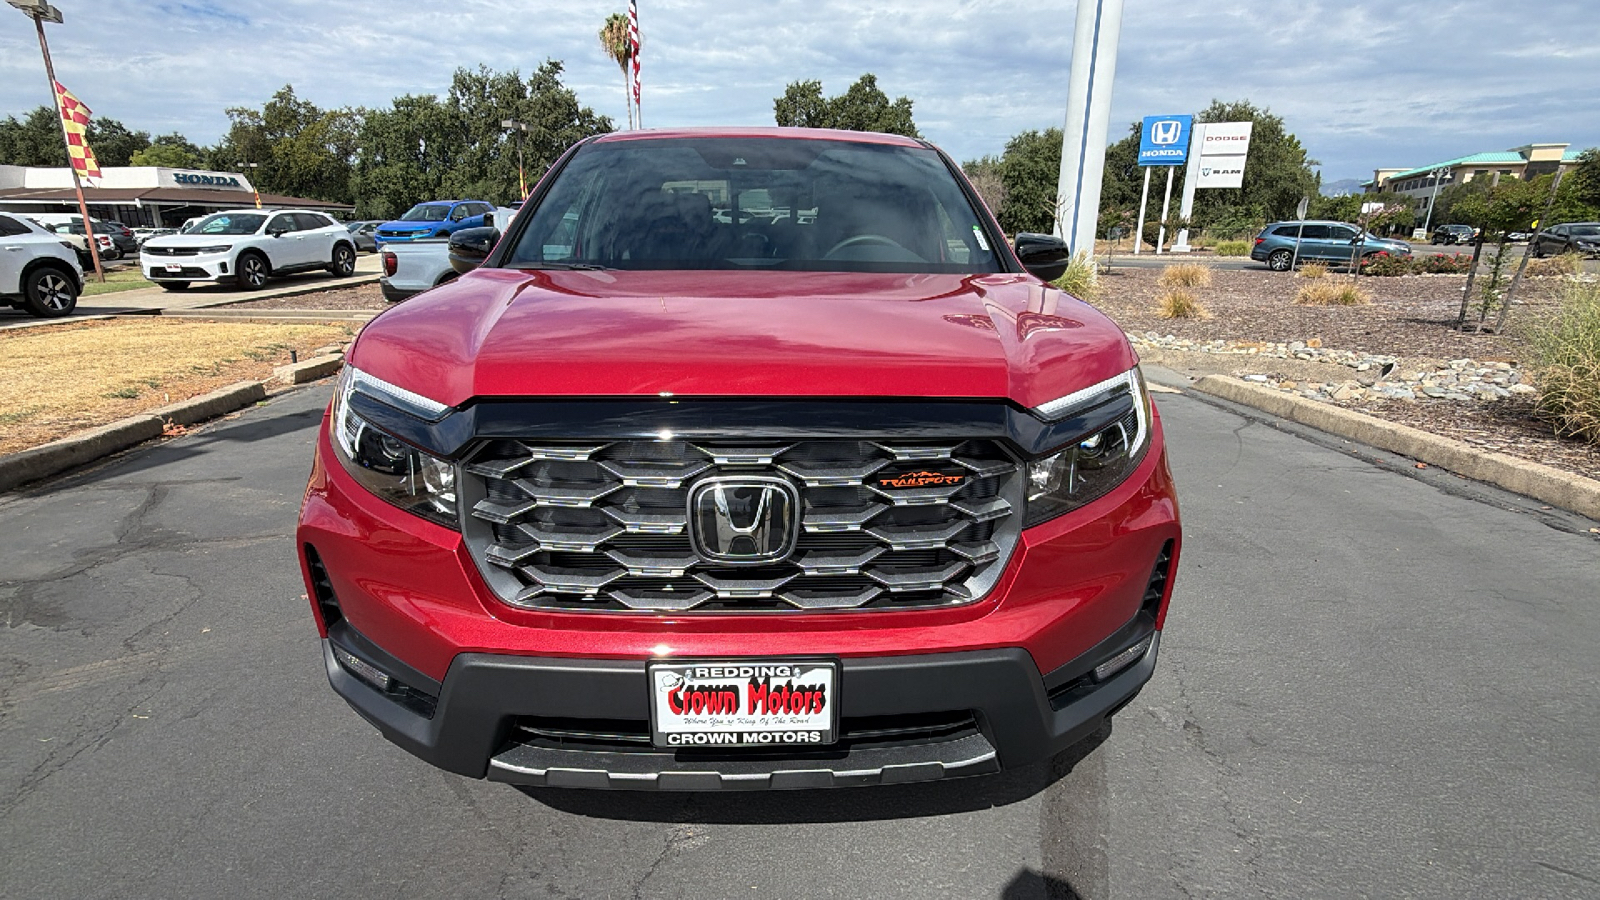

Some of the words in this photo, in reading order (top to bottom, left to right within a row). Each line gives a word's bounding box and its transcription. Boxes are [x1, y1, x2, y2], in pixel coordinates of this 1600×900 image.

[1141, 149, 1184, 157] HONDA
[173, 173, 241, 186] HONDA
[880, 475, 964, 487] TRAILSPORT
[695, 667, 791, 678] REDDING
[668, 684, 739, 715] Crown
[748, 679, 825, 715] Motors
[668, 732, 737, 744] CROWN
[742, 731, 821, 744] MOTORS
